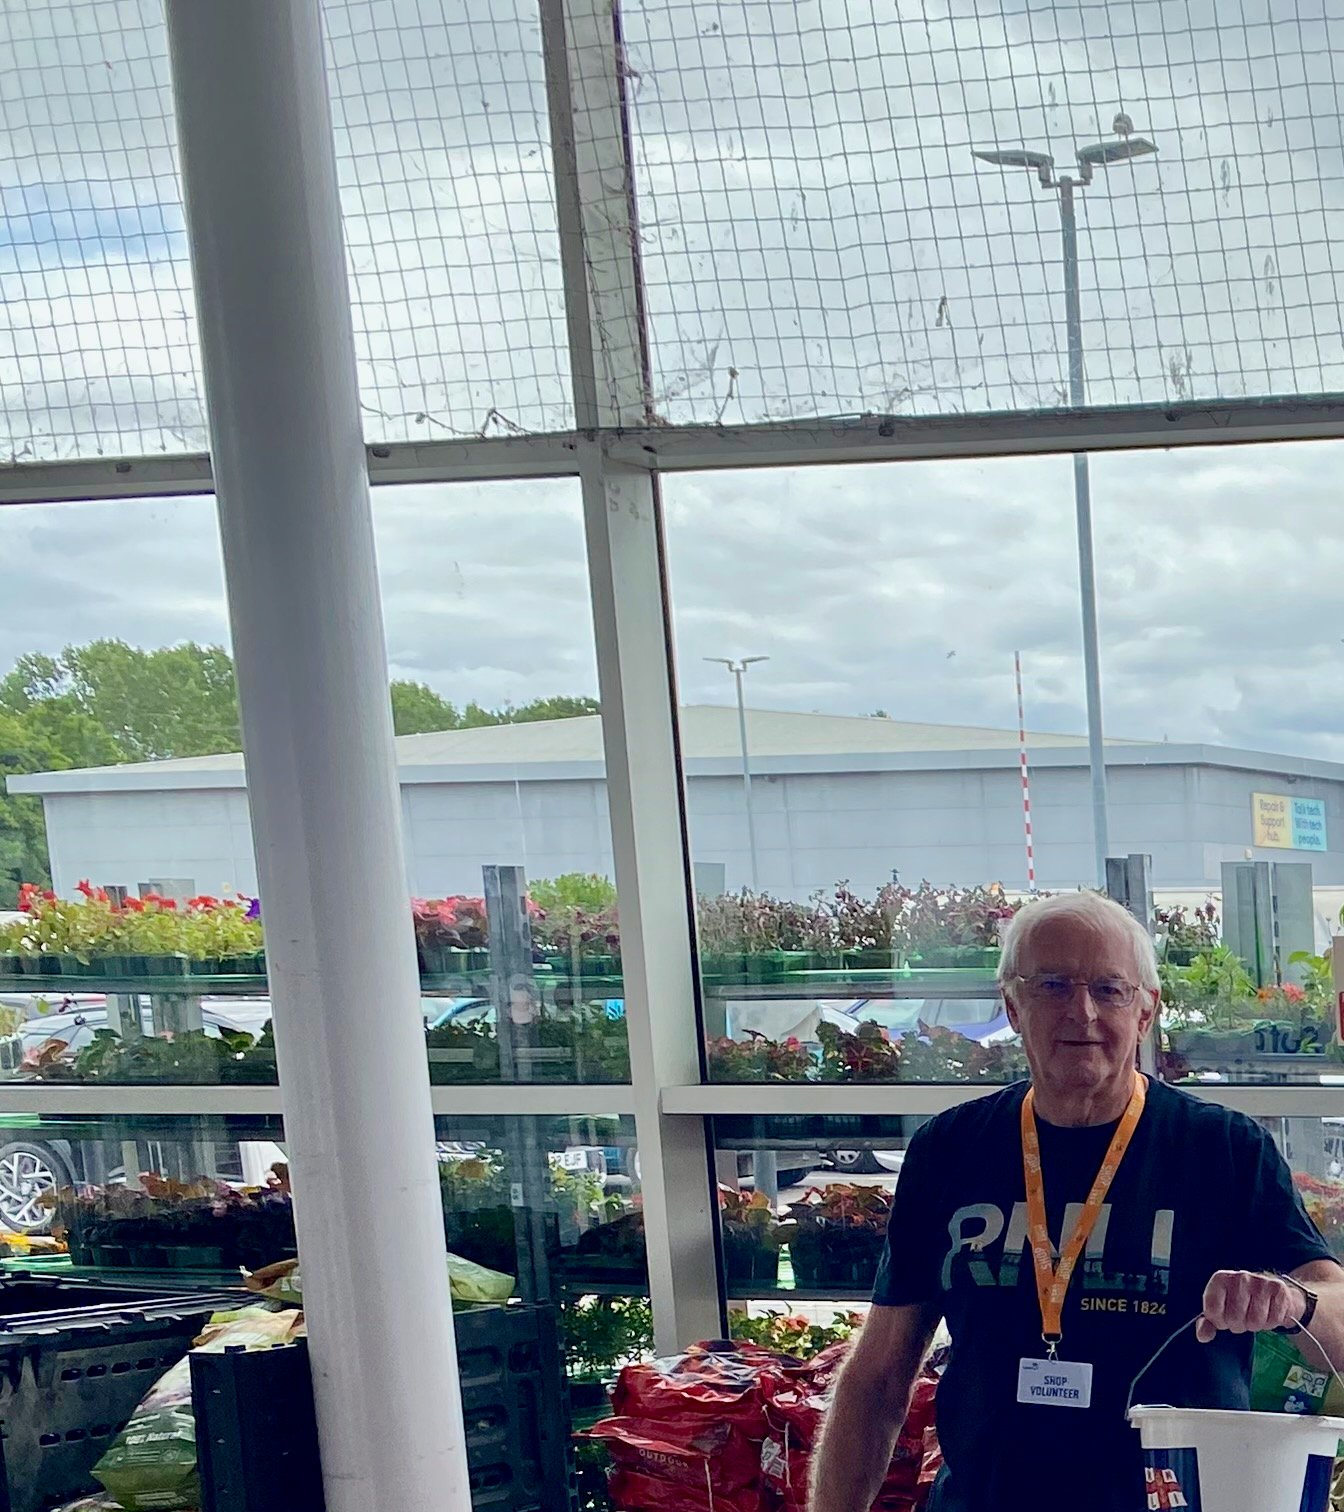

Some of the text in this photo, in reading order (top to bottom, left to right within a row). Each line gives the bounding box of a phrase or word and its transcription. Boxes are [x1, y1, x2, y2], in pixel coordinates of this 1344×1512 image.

[1080, 1298, 1167, 1316] SINCE 1824
[1043, 1375, 1068, 1386] SHOP
[1030, 1386, 1080, 1400] VOLUNTEER
